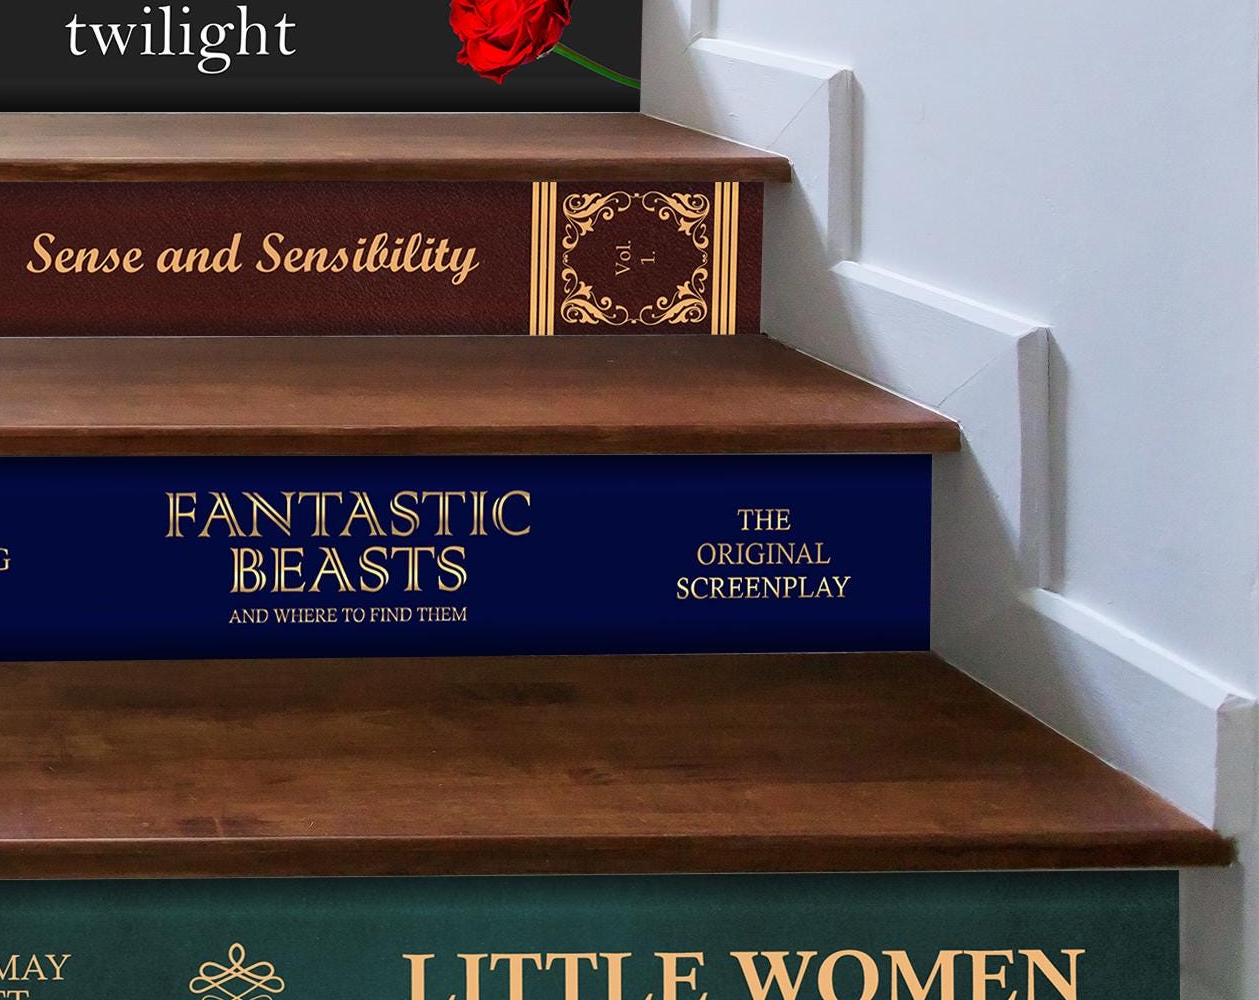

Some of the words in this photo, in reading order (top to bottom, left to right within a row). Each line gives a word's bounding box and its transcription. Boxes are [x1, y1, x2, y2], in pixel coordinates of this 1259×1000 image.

[65, 6, 295, 74] twilight
[27, 233, 144, 273] Sense
[157, 233, 242, 272] and
[256, 233, 479, 285] Sensibility
[615, 241, 631, 275] Vol.
[641, 251, 655, 264] 1.
[166, 491, 530, 537] FANTASTIC
[738, 509, 790, 530] THE
[231, 546, 466, 592] BEASTS
[698, 543, 830, 565] ORIGINAL
[677, 576, 851, 599] SCREENPLAY
[229, 609, 268, 623] AND
[274, 608, 337, 623] WHERE
[342, 608, 365, 622] TO
[371, 608, 412, 622] FIND
[417, 607, 466, 621] THEM
[403, 952, 707, 1000] LITTLE
[730, 949, 1085, 1000] WOMEN
